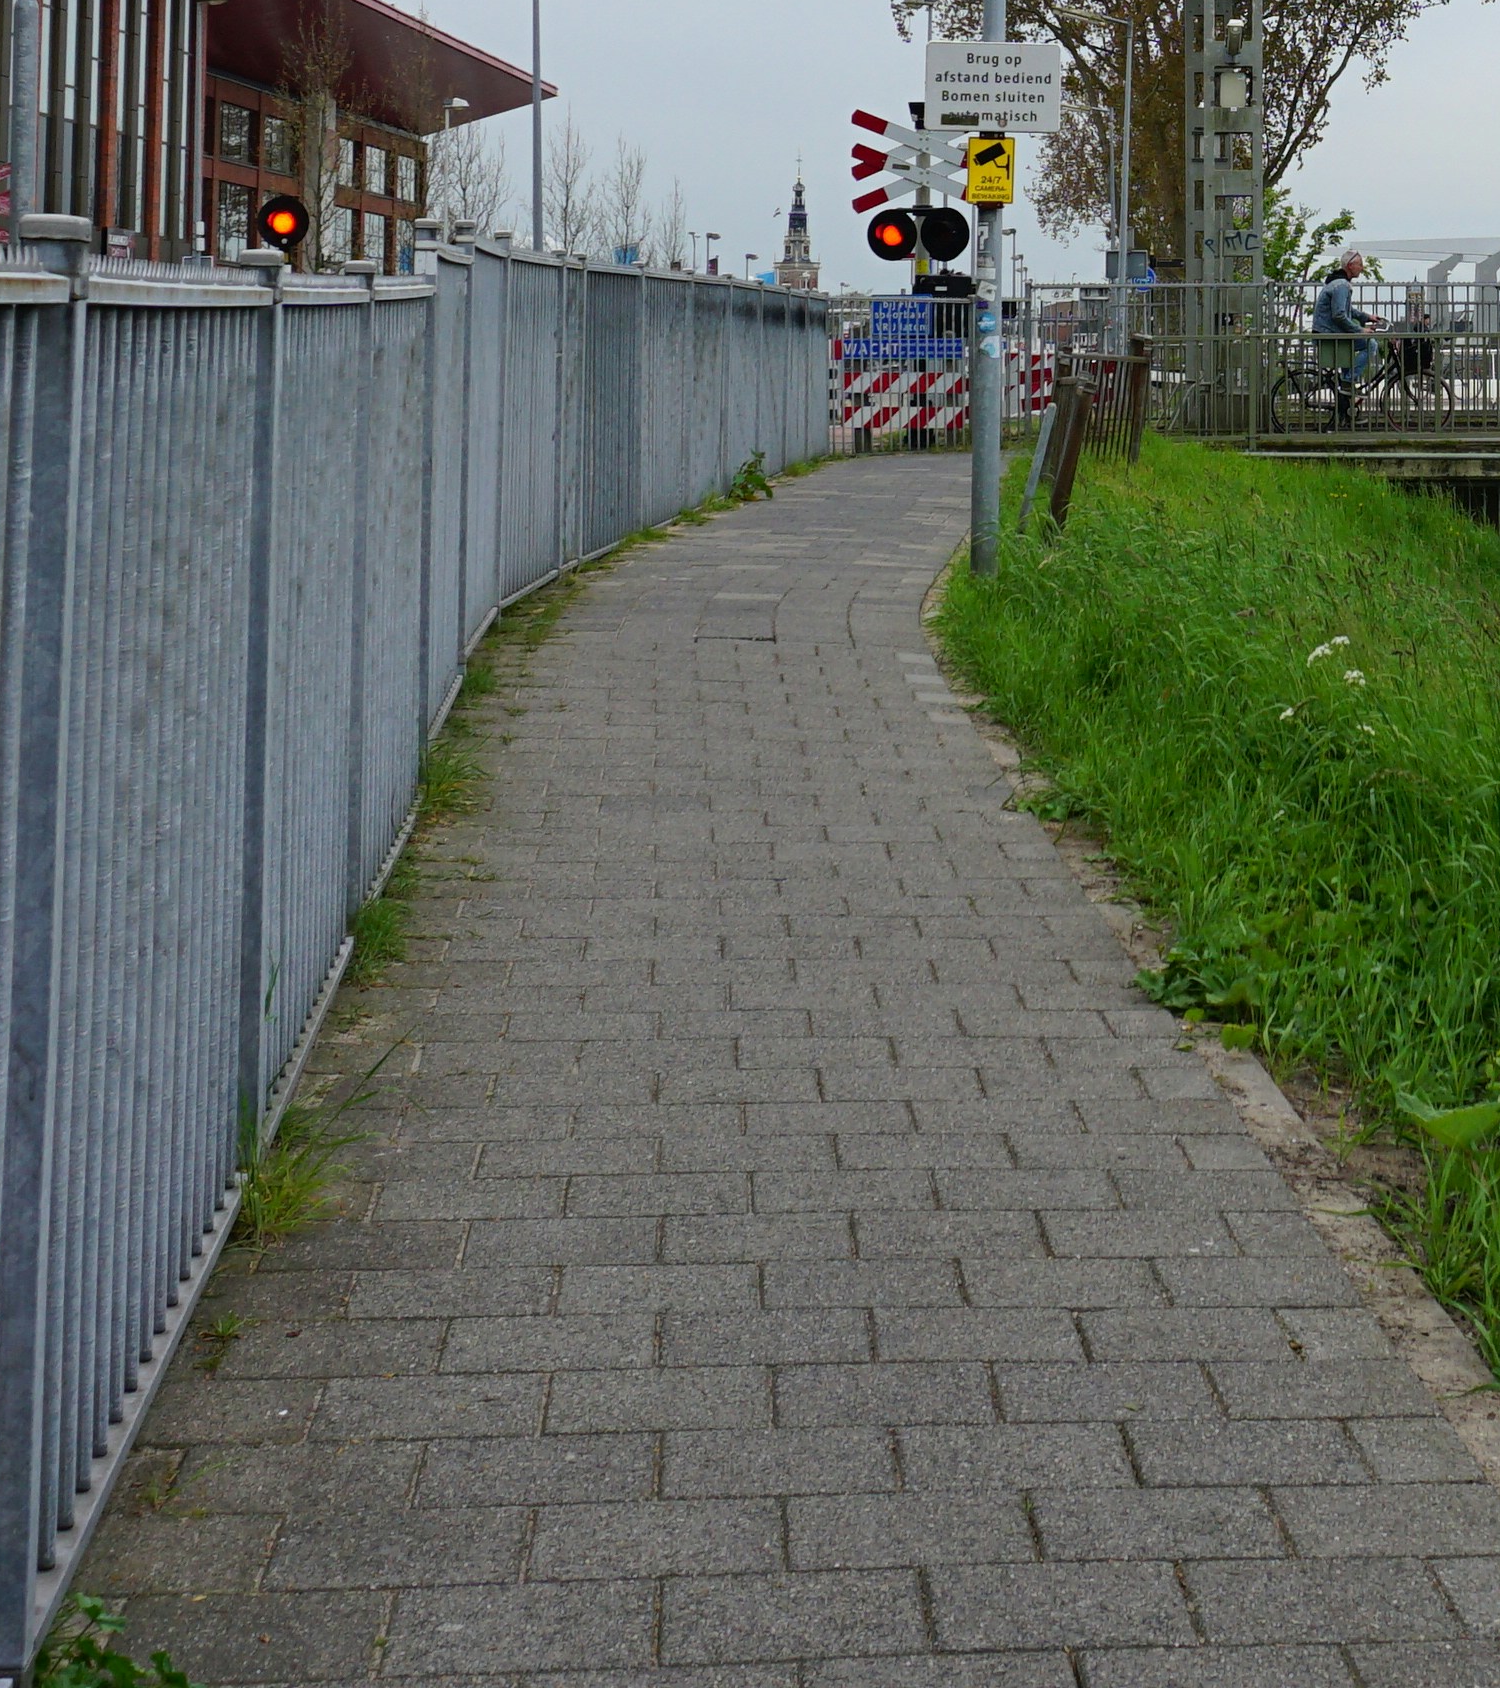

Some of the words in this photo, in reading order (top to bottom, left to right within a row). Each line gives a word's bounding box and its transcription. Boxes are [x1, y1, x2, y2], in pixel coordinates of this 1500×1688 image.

[966, 53, 999, 67] Brug
[1005, 55, 1022, 67] op
[935, 71, 989, 83] afstand
[994, 72, 1052, 84] bediend
[941, 90, 990, 102] Bomen
[994, 91, 1045, 103] sluiten
[980, 175, 1002, 184] 24/7
[843, 342, 899, 355] WACHT
